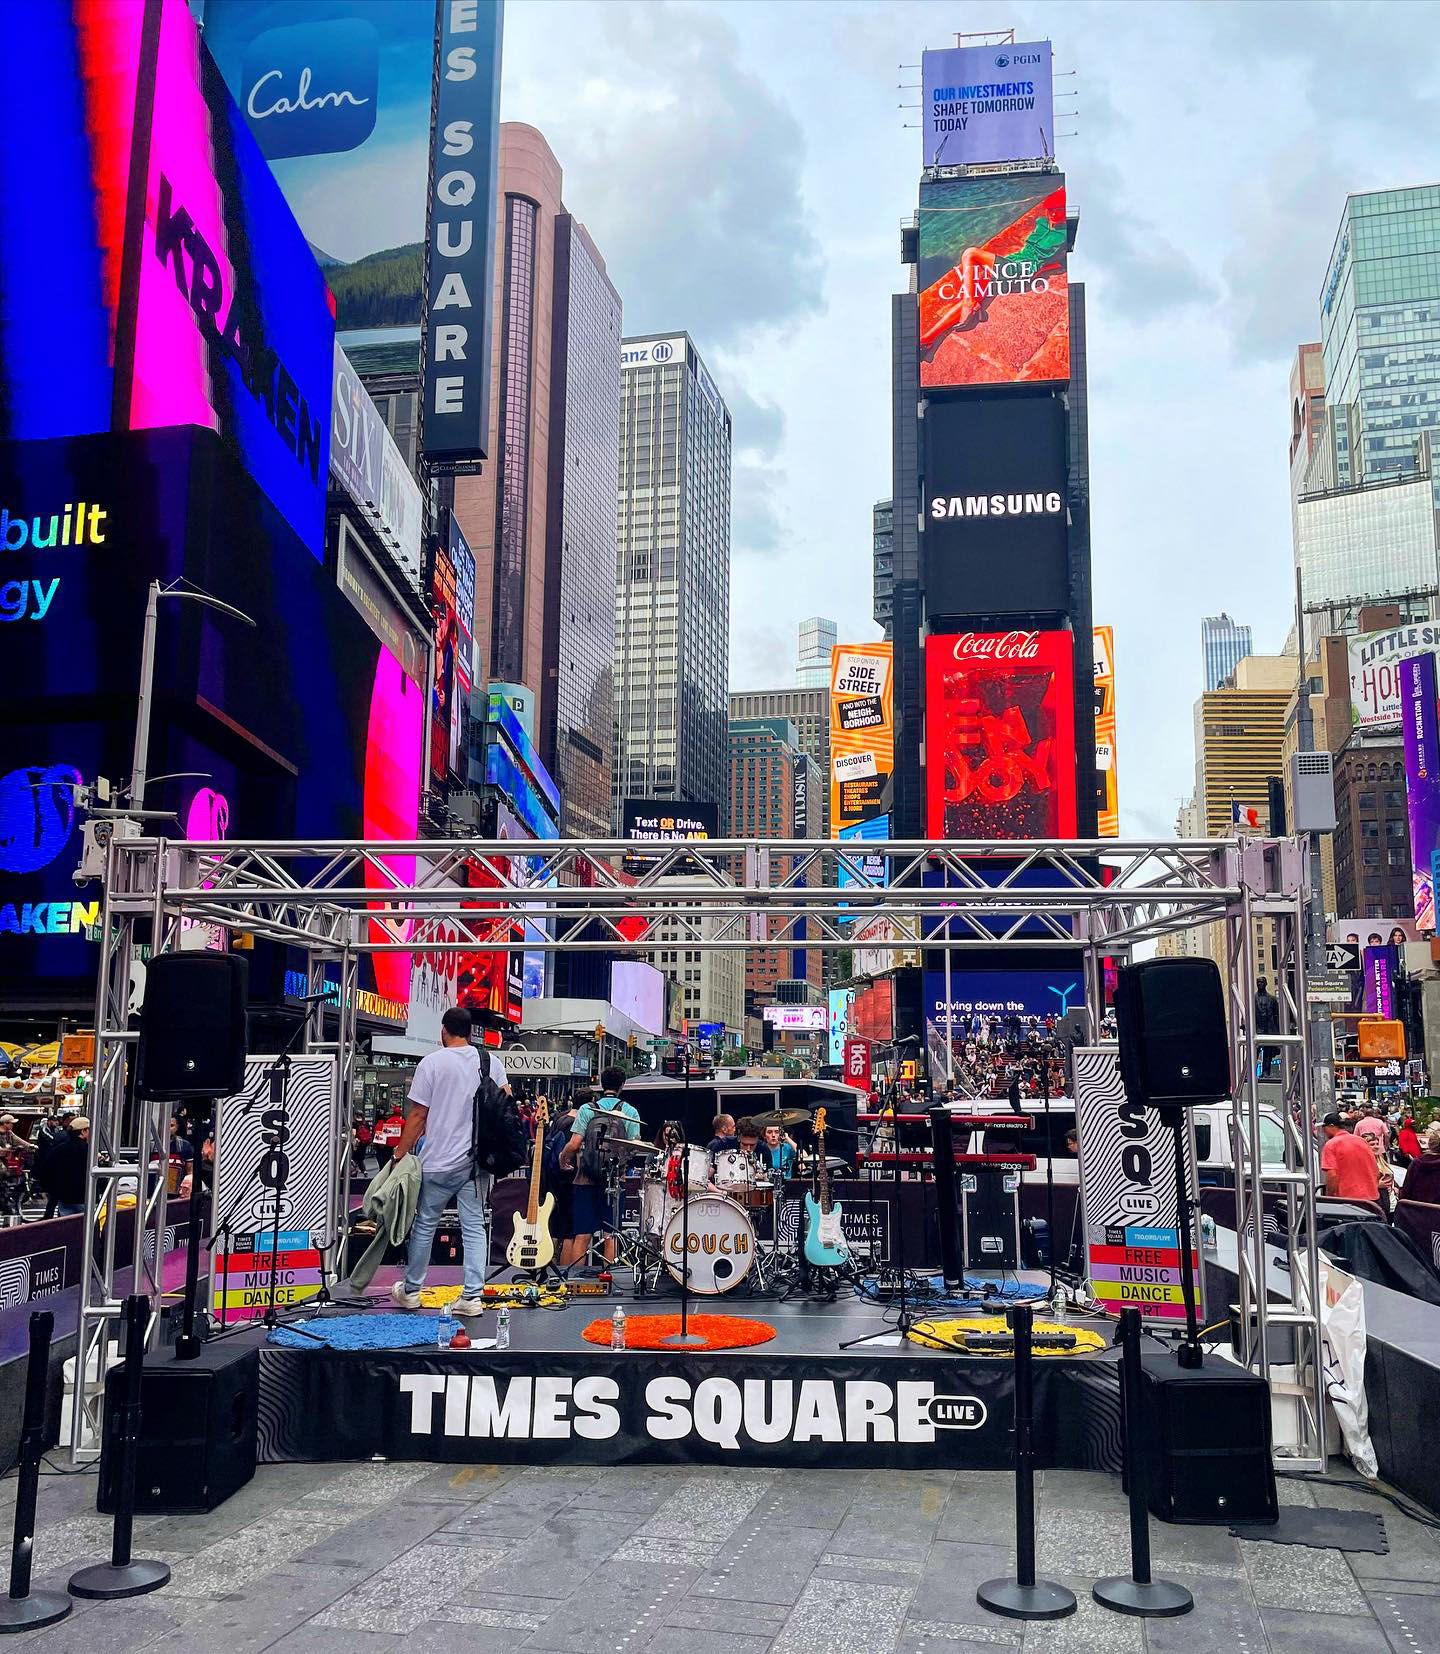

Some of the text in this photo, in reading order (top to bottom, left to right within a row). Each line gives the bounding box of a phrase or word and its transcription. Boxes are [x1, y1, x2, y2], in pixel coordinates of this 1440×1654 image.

[1013, 54, 1041, 65] PGIM
[247, 67, 369, 119] Calm
[933, 81, 1034, 101] OUR INVESTMENTS
[933, 97, 1035, 117] SHAPE TOMORROW
[933, 118, 968, 132] TODAY
[433, 121, 477, 414] SQUARE
[953, 261, 1034, 281] VINCE
[938, 278, 1049, 300] CAMUTO
[931, 492, 1062, 518] SAMSUNG
[0, 502, 107, 551] built
[953, 630, 1040, 660] Coca-Cola
[1361, 628, 1418, 666] LITTLE
[849, 666, 876, 680] SIDE
[839, 679, 881, 694] STREET
[848, 706, 875, 719] NEIGH-
[1360, 714, 1391, 724] Westside
[843, 715, 882, 729] BORHOOD
[836, 754, 872, 768] DISCOVER
[634, 816, 705, 830] Text OR Drive.
[630, 829, 708, 841] There Is No AND
[975, 1001, 1004, 1010] down
[1006, 1001, 1024, 1010] the
[504, 1056, 556, 1070] ROVSKI
[851, 1043, 866, 1076] tkts
[863, 1160, 883, 1169] nord
[1000, 1162, 1022, 1170] stage
[1126, 1199, 1153, 1209] LIVE
[842, 1213, 879, 1224] TIMES
[671, 1232, 749, 1255] COUCH
[1125, 1249, 1163, 1264] FREE
[35, 1266, 59, 1287] TIMES
[1119, 1266, 1170, 1283] MUSIC
[1121, 1285, 1172, 1302] DANCE
[399, 1373, 975, 1450] TIMES SQUARE LIVE
